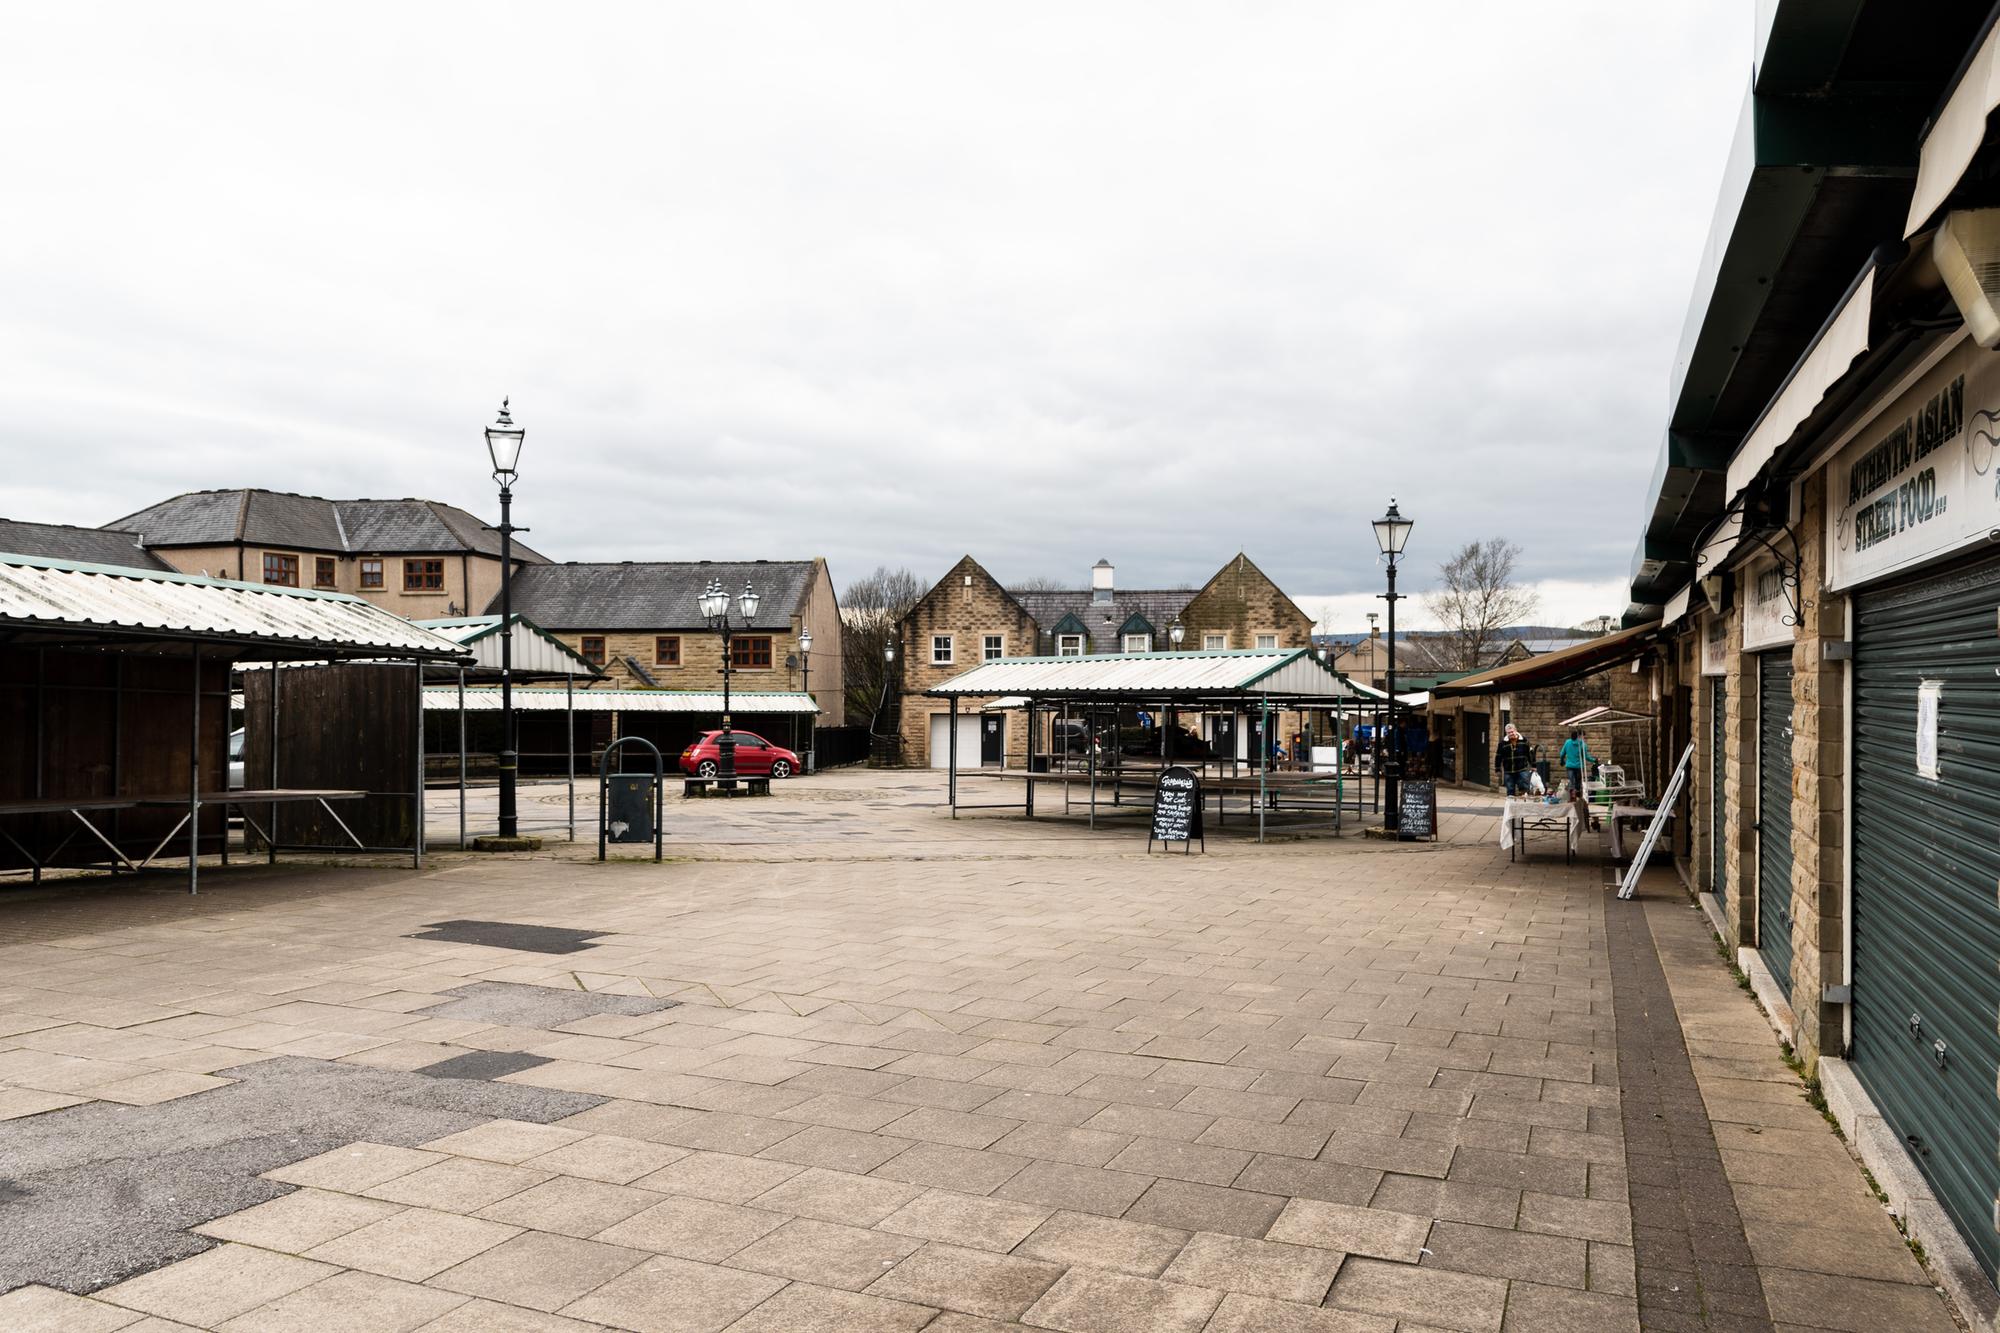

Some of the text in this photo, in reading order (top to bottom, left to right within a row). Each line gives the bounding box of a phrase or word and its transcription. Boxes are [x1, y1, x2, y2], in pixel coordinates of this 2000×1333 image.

[1849, 373, 1964, 507] AUTHENTIC ASIAN
[1855, 488, 1898, 553] STREET
